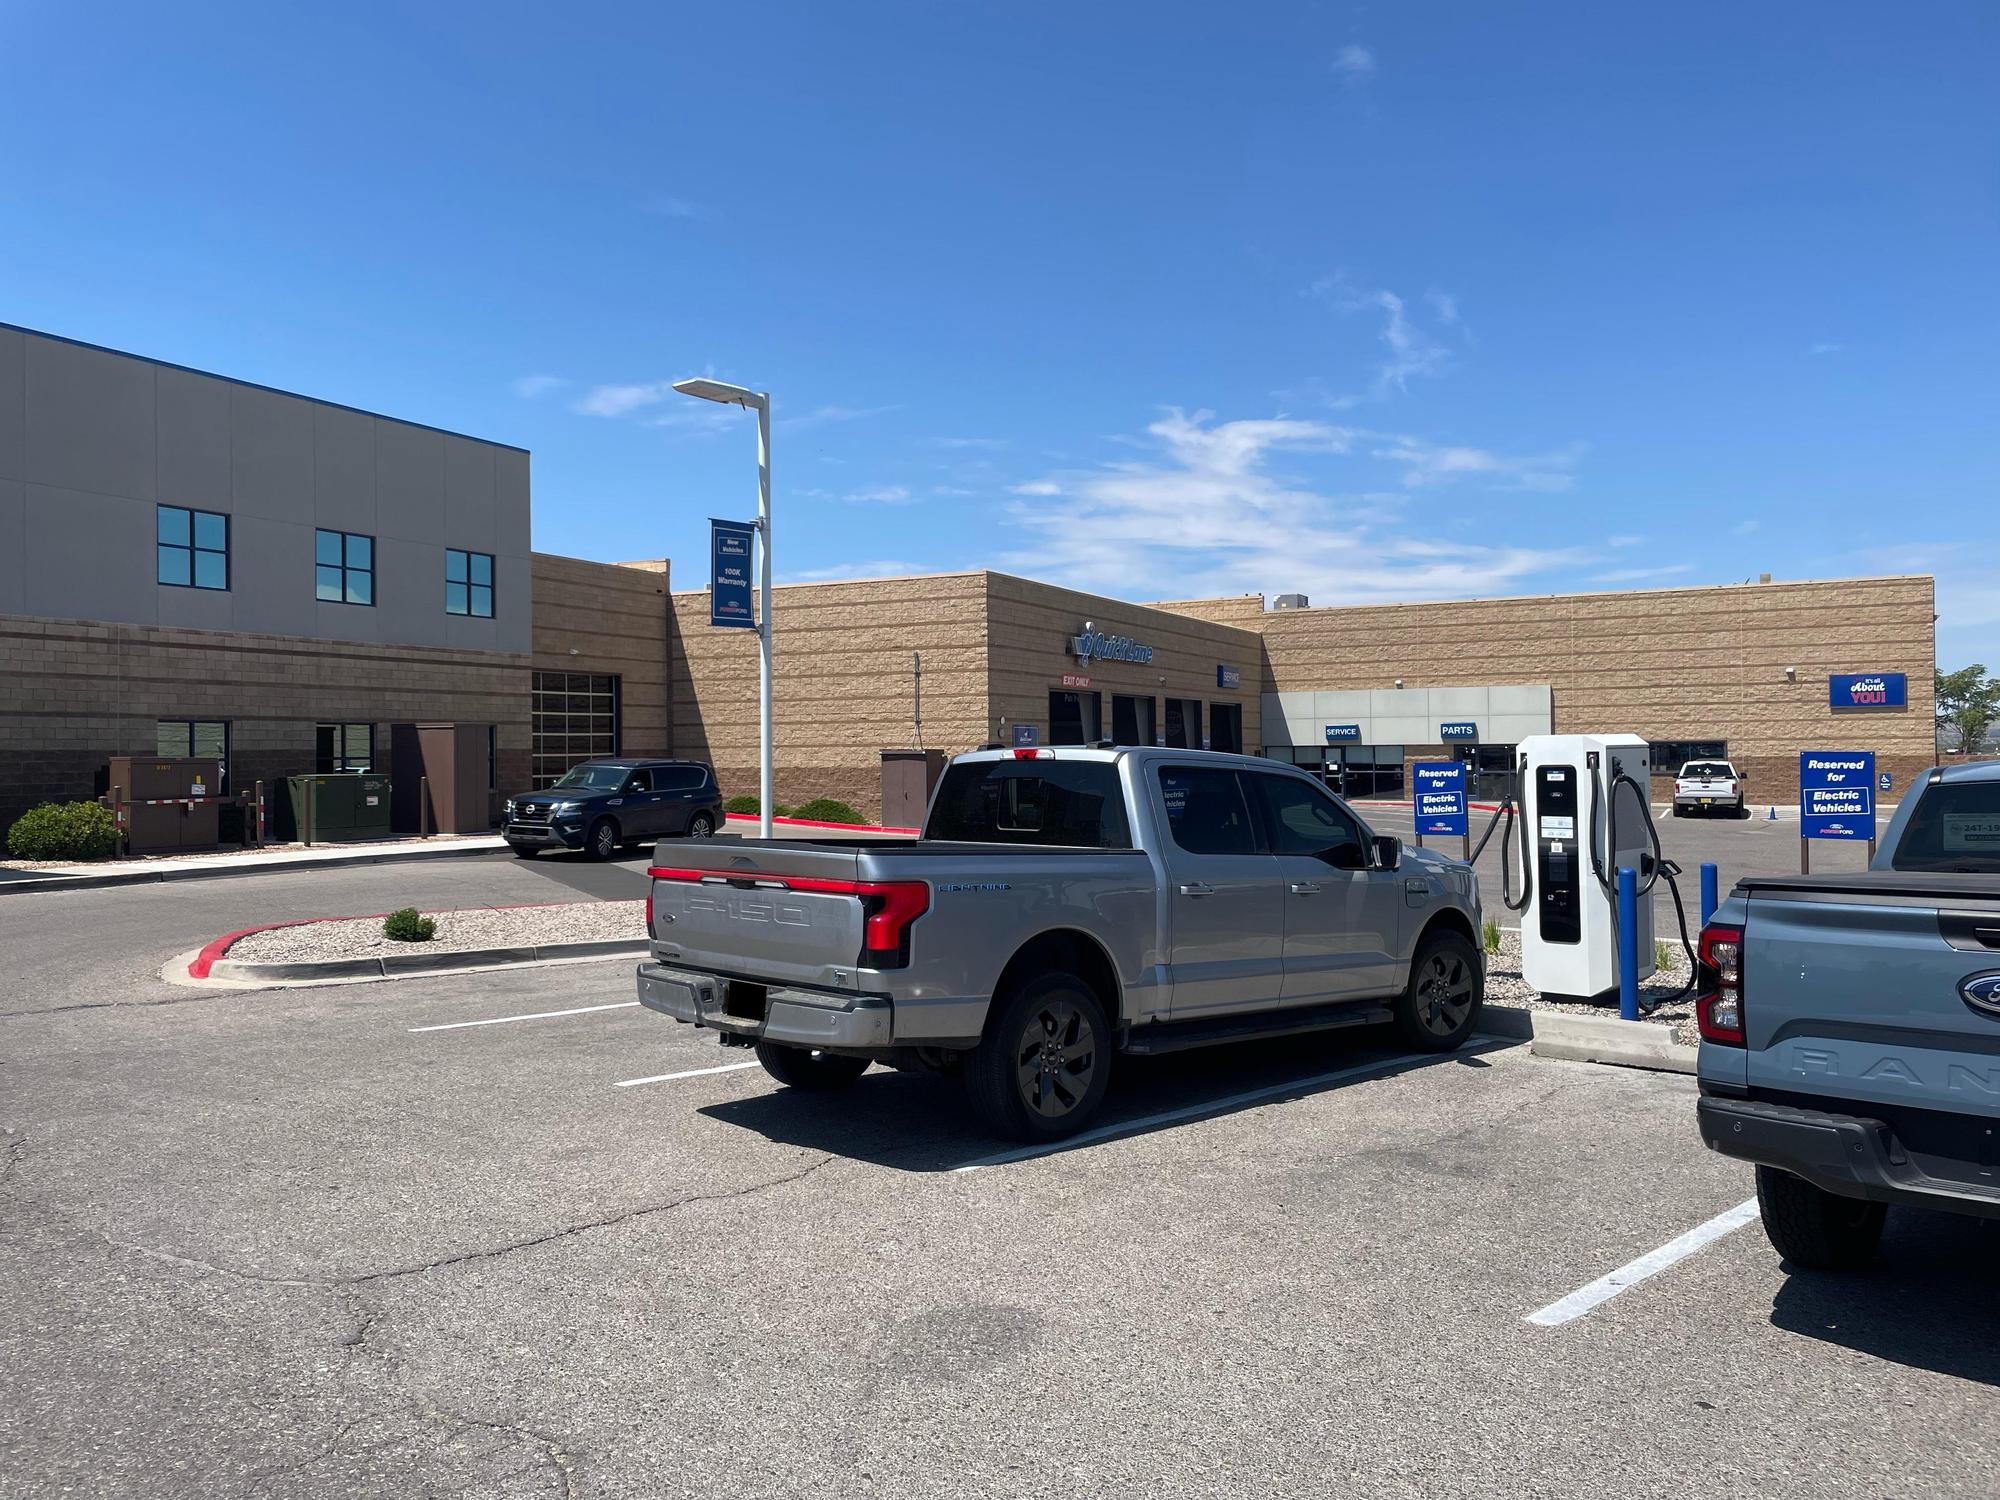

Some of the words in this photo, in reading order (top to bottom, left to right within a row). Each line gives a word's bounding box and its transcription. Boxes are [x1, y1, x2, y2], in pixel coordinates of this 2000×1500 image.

[725, 568, 741, 576] 100K
[718, 576, 747, 587] Warranty
[1063, 675, 1076, 685] EXIT
[1076, 676, 1090, 687] ONLY
[1851, 682, 1885, 692] About
[1442, 726, 1473, 734] PARTS
[1808, 760, 1864, 769] Reserved
[1419, 769, 1459, 777] Reserved
[1827, 773, 1845, 782] for
[1423, 795, 1455, 803] Electric
[1813, 791, 1859, 800] Electric
[1423, 805, 1458, 813] Vehicles
[1813, 803, 1862, 813] Vehicles
[939, 883, 1012, 892] LIGHTNING
[682, 892, 812, 927] F-150
